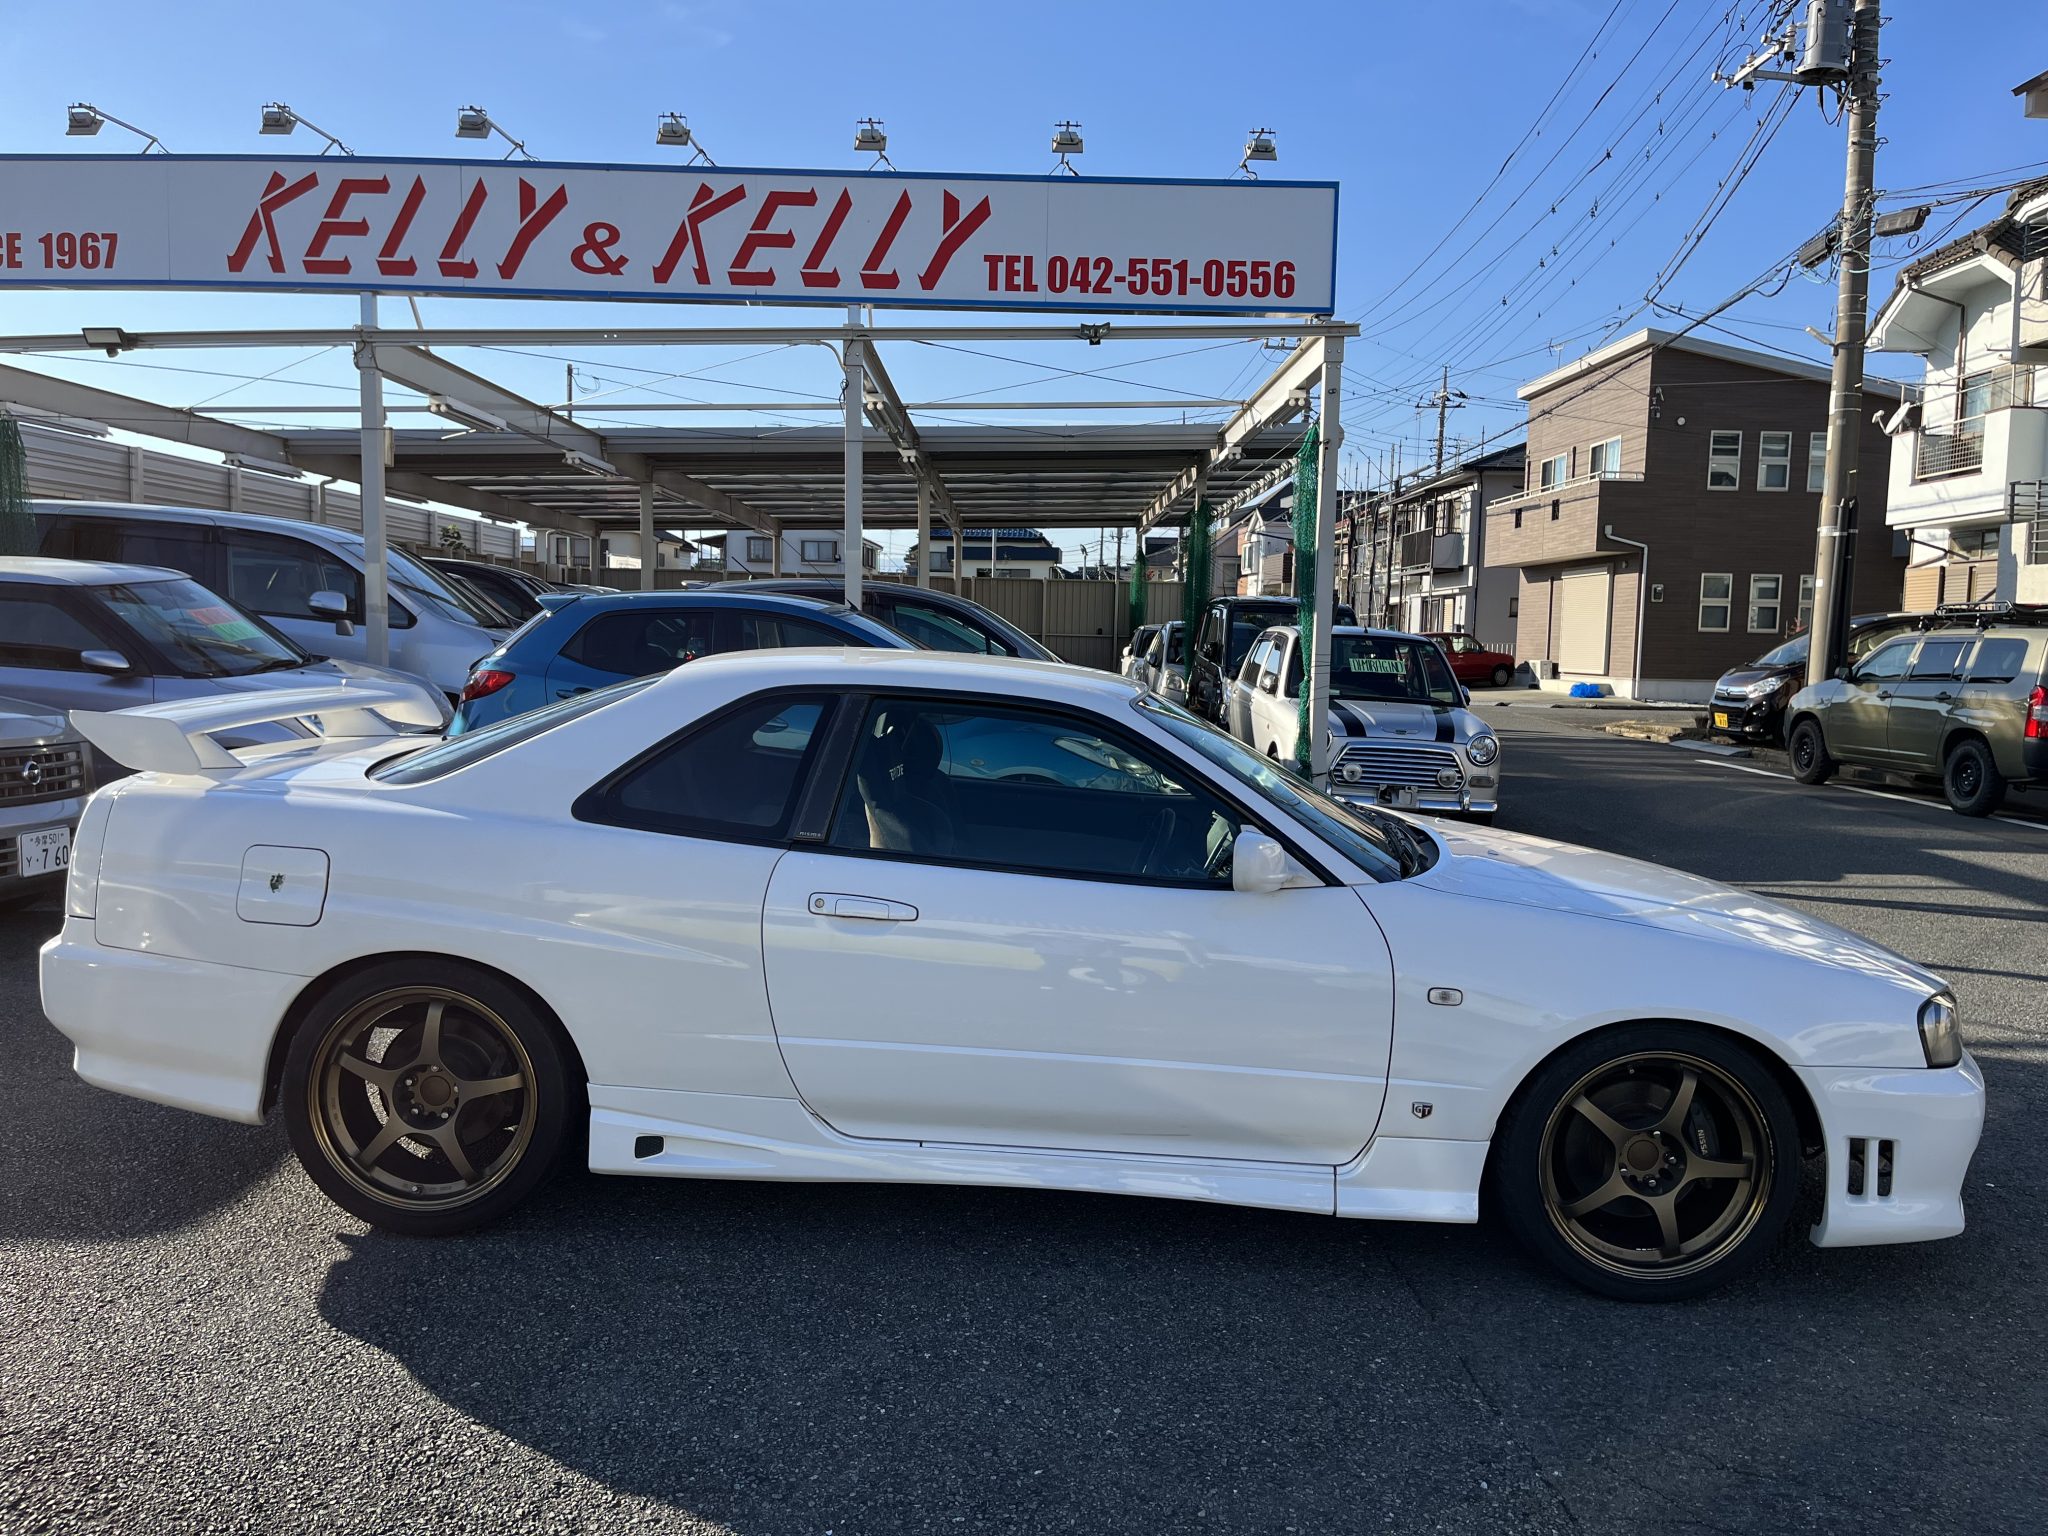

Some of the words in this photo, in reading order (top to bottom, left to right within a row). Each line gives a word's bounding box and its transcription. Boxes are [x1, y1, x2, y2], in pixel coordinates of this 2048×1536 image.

[227, 171, 568, 279] KELLY
[570, 222, 628, 275] &
[652, 182, 991, 291] KELLY
[0, 233, 22, 268] E
[38, 232, 118, 269] 1967
[984, 254, 1038, 292] TEL
[1047, 255, 1295, 298] 042-551-0556
[1414, 1105, 1431, 1116] GT
[1697, 1129, 1709, 1156] NISSA
